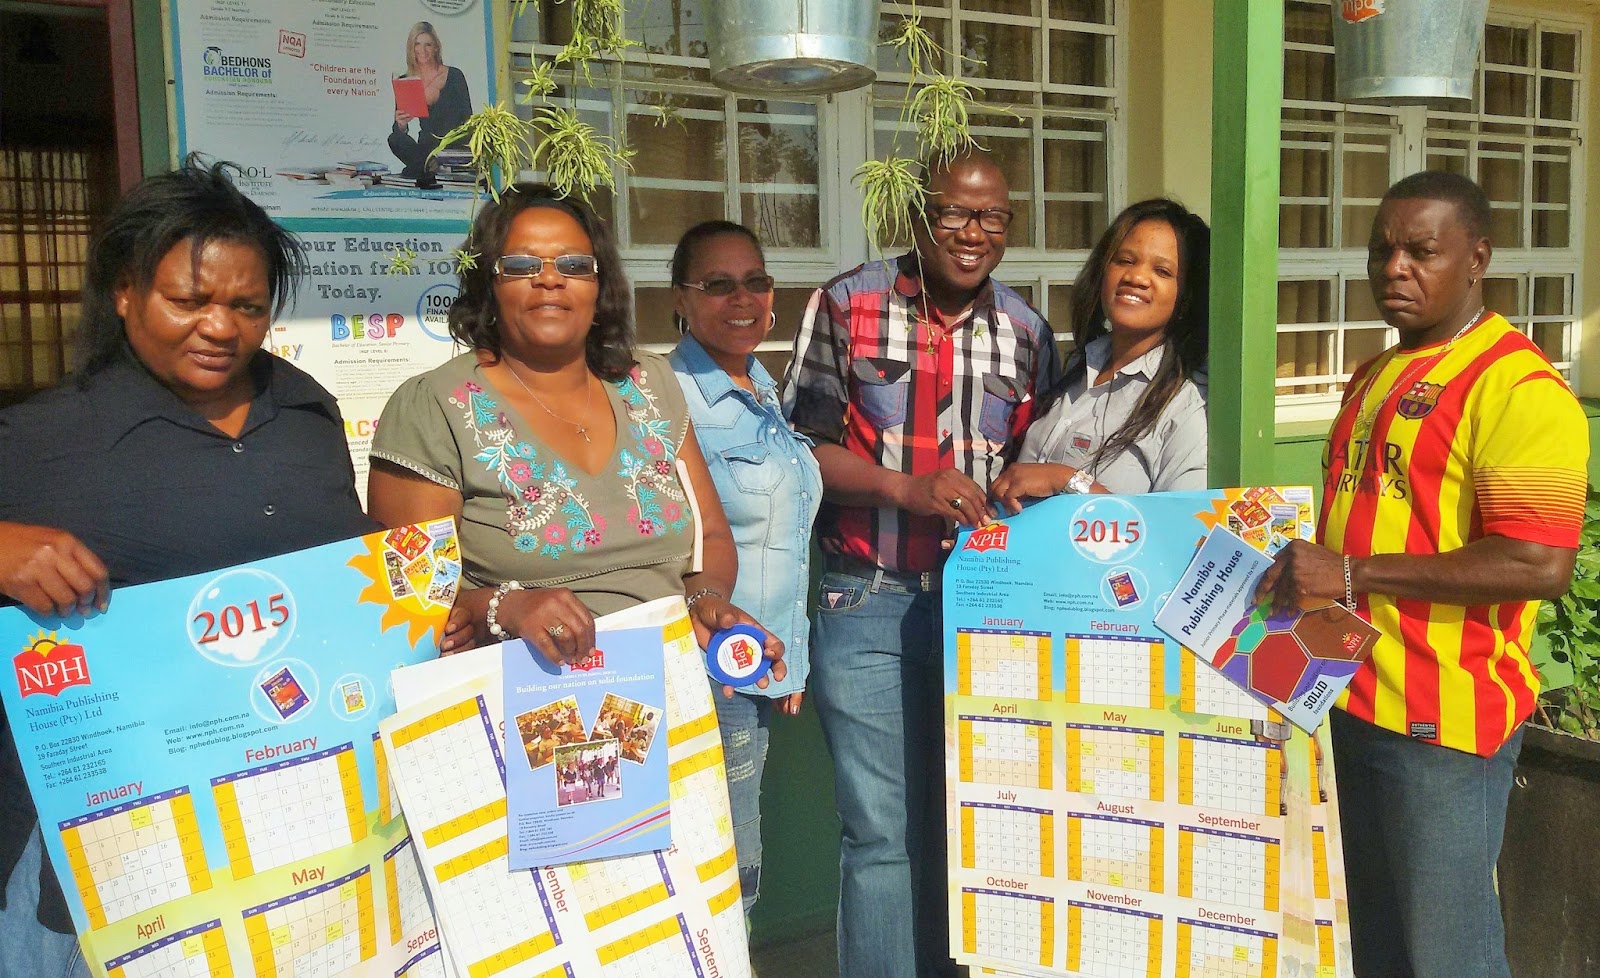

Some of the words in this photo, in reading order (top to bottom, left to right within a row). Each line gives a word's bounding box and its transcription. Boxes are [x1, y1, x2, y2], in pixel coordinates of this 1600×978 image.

[282, 34, 302, 47] NQA
[221, 56, 272, 68] BEDHONS
[364, 66, 376, 74] the
[203, 66, 258, 78] BACHELOR
[262, 68, 272, 78] of
[324, 76, 366, 85] Foundation
[368, 77, 377, 86] of
[326, 88, 348, 98] every
[300, 240, 336, 252] our
[344, 238, 444, 252] Education
[318, 284, 382, 303] Today.
[330, 313, 404, 341] BESP
[965, 532, 1007, 548] NPH
[1074, 520, 1140, 544] 2015
[979, 565, 994, 574] (Pty)
[986, 556, 1020, 565] Publishing
[1181, 560, 1216, 604] Namibia
[1182, 583, 1224, 636] Publishing
[1216, 550, 1242, 582] House
[194, 593, 290, 644] 2015
[982, 616, 1024, 628] January
[1090, 620, 1140, 634] February
[1208, 620, 1220, 636] Primary
[1347, 634, 1362, 652] NPH
[732, 642, 750, 668] NPH
[18, 656, 88, 692] NPH
[516, 684, 547, 694] Building
[598, 676, 614, 684] solid
[616, 673, 655, 683] foundation
[26, 703, 64, 718] Namibia
[66, 690, 120, 710] Publishing
[1304, 680, 1328, 710] SOLID
[1313, 688, 1334, 714] foundations
[993, 704, 1018, 715] April
[1104, 711, 1127, 724] May
[30, 718, 58, 732] House
[60, 712, 82, 727] (Pty)
[85, 707, 102, 720] Ltd
[164, 725, 188, 736] Email:
[189, 712, 250, 730] info@nph.com.na
[1216, 722, 1242, 735] June
[61, 736, 80, 746] 22830
[80, 728, 114, 741] Windhoek,
[116, 720, 146, 732] Namibia
[166, 736, 184, 745] Web:
[186, 723, 244, 740] www.nph.com.na
[168, 746, 187, 755] Blog:
[189, 725, 278, 750] nphedublog.blogspot.com
[40, 760, 66, 770] Southern
[67, 752, 96, 764] Industrial
[98, 748, 112, 756] Area
[46, 748, 68, 759] Faraday
[70, 743, 88, 753] Street
[245, 736, 318, 764] February
[58, 767, 72, 777] +264
[82, 760, 106, 771] 232165
[59, 776, 74, 786] +264
[84, 768, 108, 779] 233538
[86, 780, 144, 806] January
[996, 790, 1018, 802] July
[1097, 800, 1134, 815] August
[1198, 812, 1260, 832] September
[292, 865, 326, 886] May
[986, 876, 1028, 890] October
[1086, 889, 1142, 907] November
[1198, 907, 1256, 926] December
[136, 914, 166, 940] April
[407, 926, 438, 954] Septe
[697, 928, 723, 978] Septem
